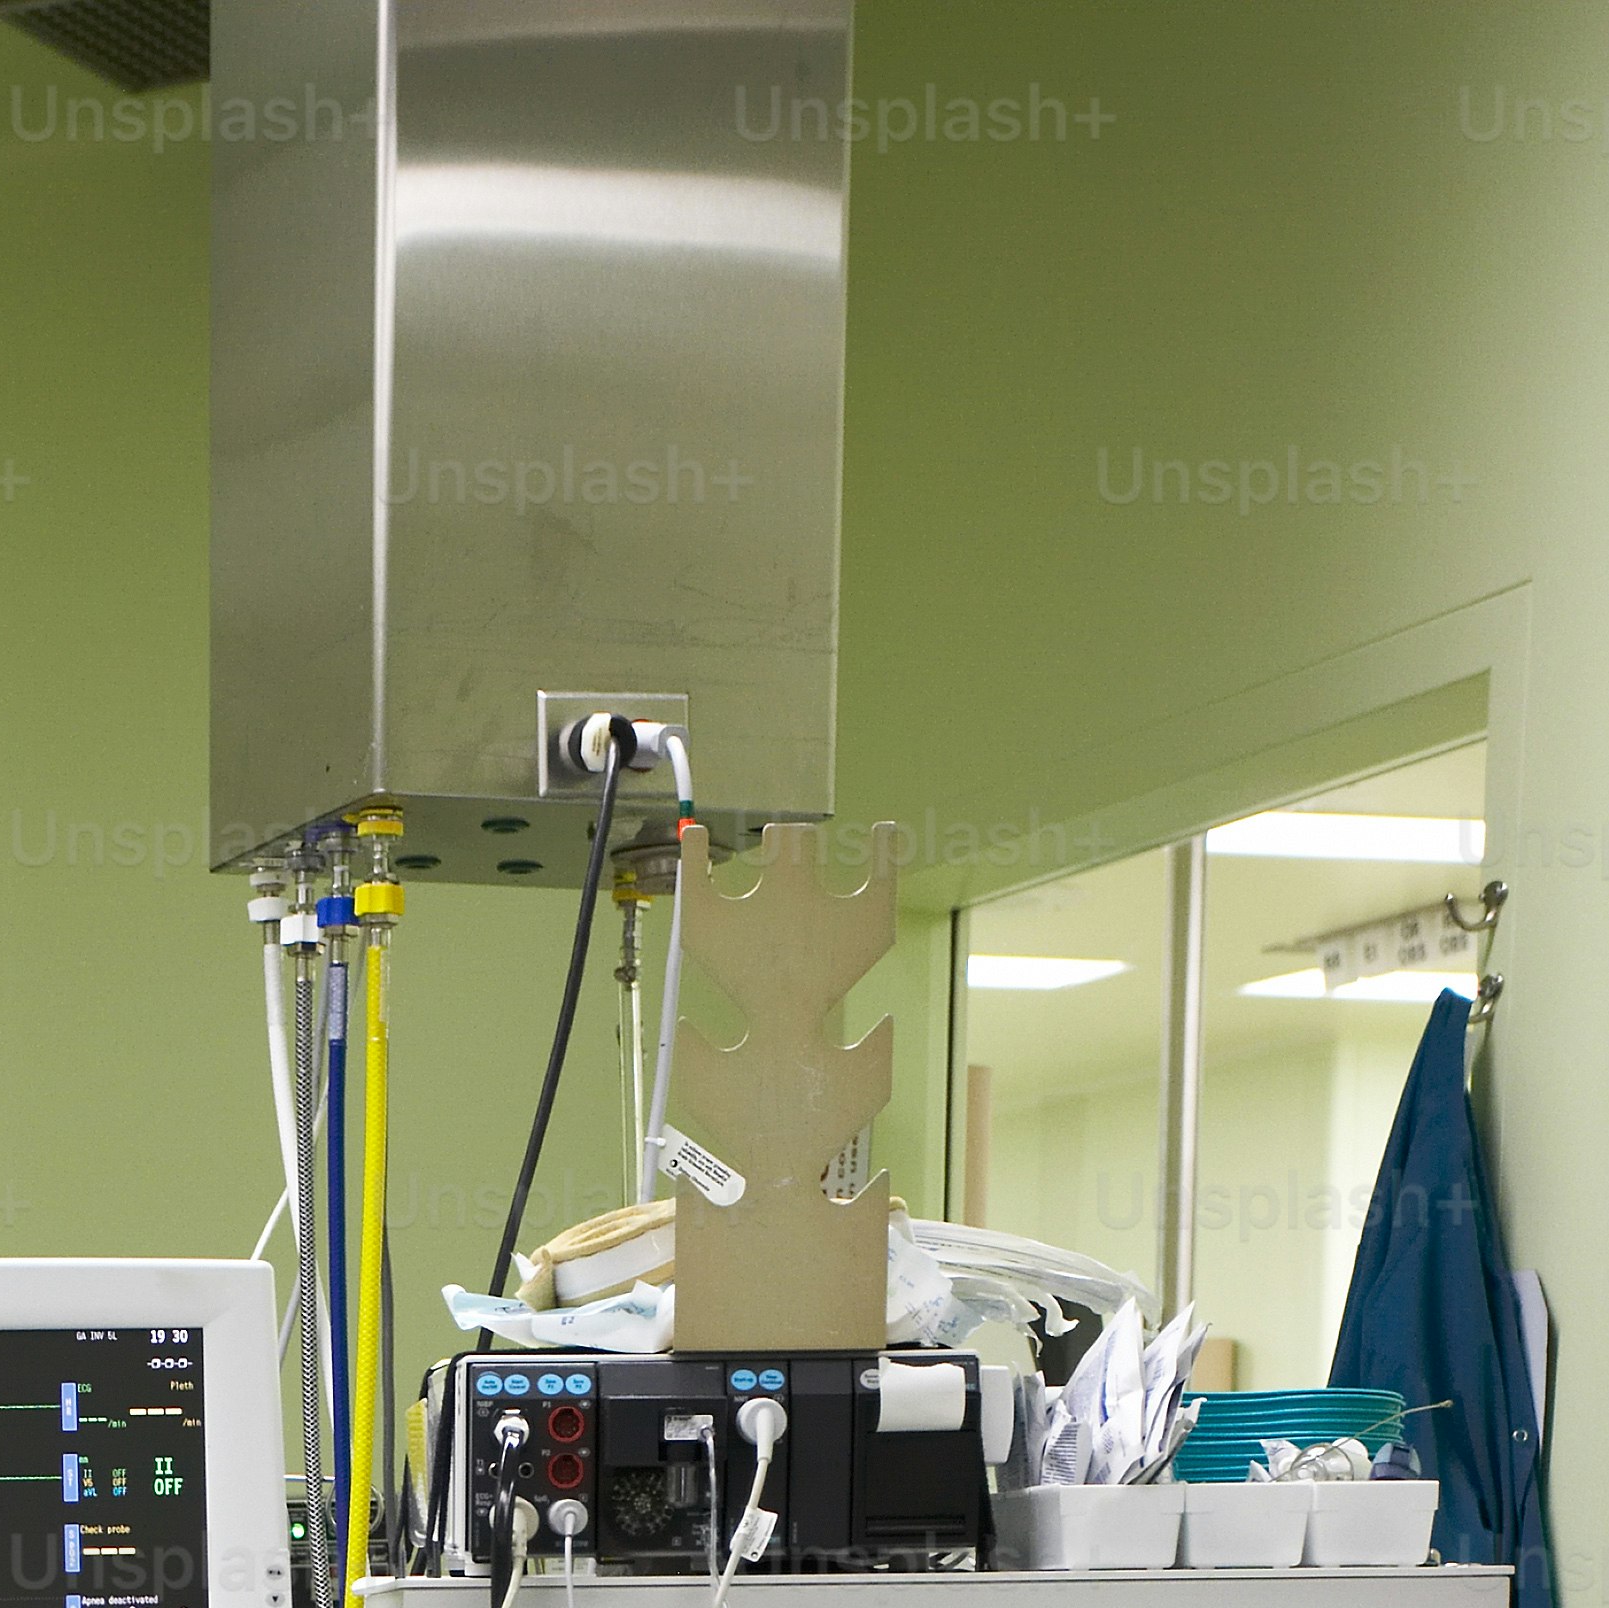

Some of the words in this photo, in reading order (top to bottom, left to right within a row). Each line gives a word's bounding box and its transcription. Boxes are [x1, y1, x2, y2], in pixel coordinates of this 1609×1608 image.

[91, 1331, 103, 1340] INV
[151, 1330, 165, 1343] 19
[172, 1330, 188, 1343] 30
[78, 1384, 92, 1393] ECG
[170, 1381, 193, 1390] Pleth
[155, 1457, 173, 1475] II
[112, 1469, 126, 1477] OFF
[112, 1478, 126, 1486] OFF
[154, 1478, 183, 1495] OFF
[113, 1487, 127, 1496] OFF
[80, 1525, 103, 1534] Check
[107, 1525, 130, 1535] probe
[82, 1597, 105, 1605] Apnea
[109, 1595, 158, 1604] deactivated
